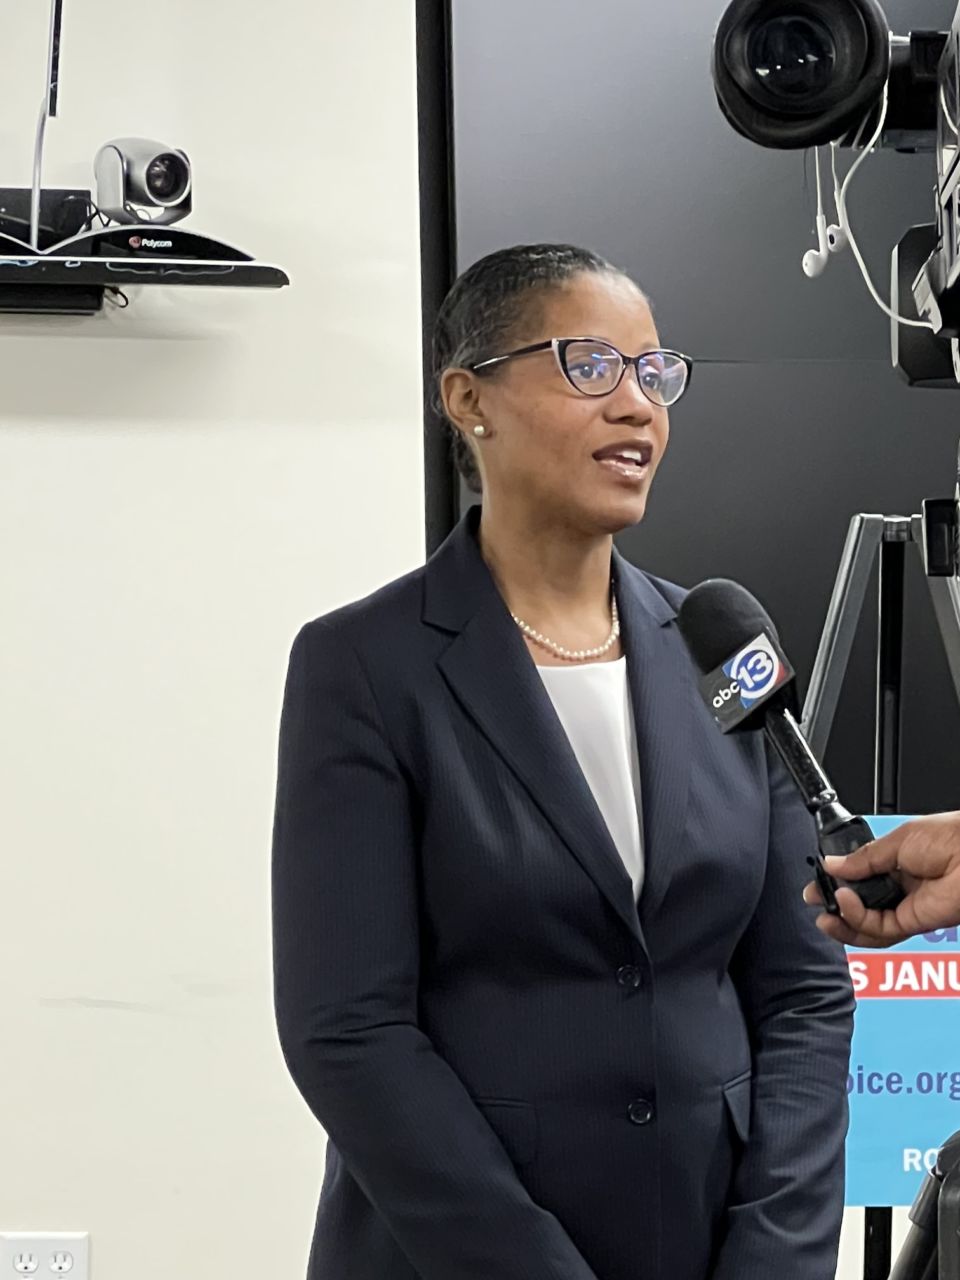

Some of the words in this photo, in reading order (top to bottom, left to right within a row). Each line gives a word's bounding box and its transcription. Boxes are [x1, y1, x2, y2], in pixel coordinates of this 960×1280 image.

[141, 238, 172, 248] Polycom
[712, 681, 740, 708] abc
[737, 652, 773, 689] 13
